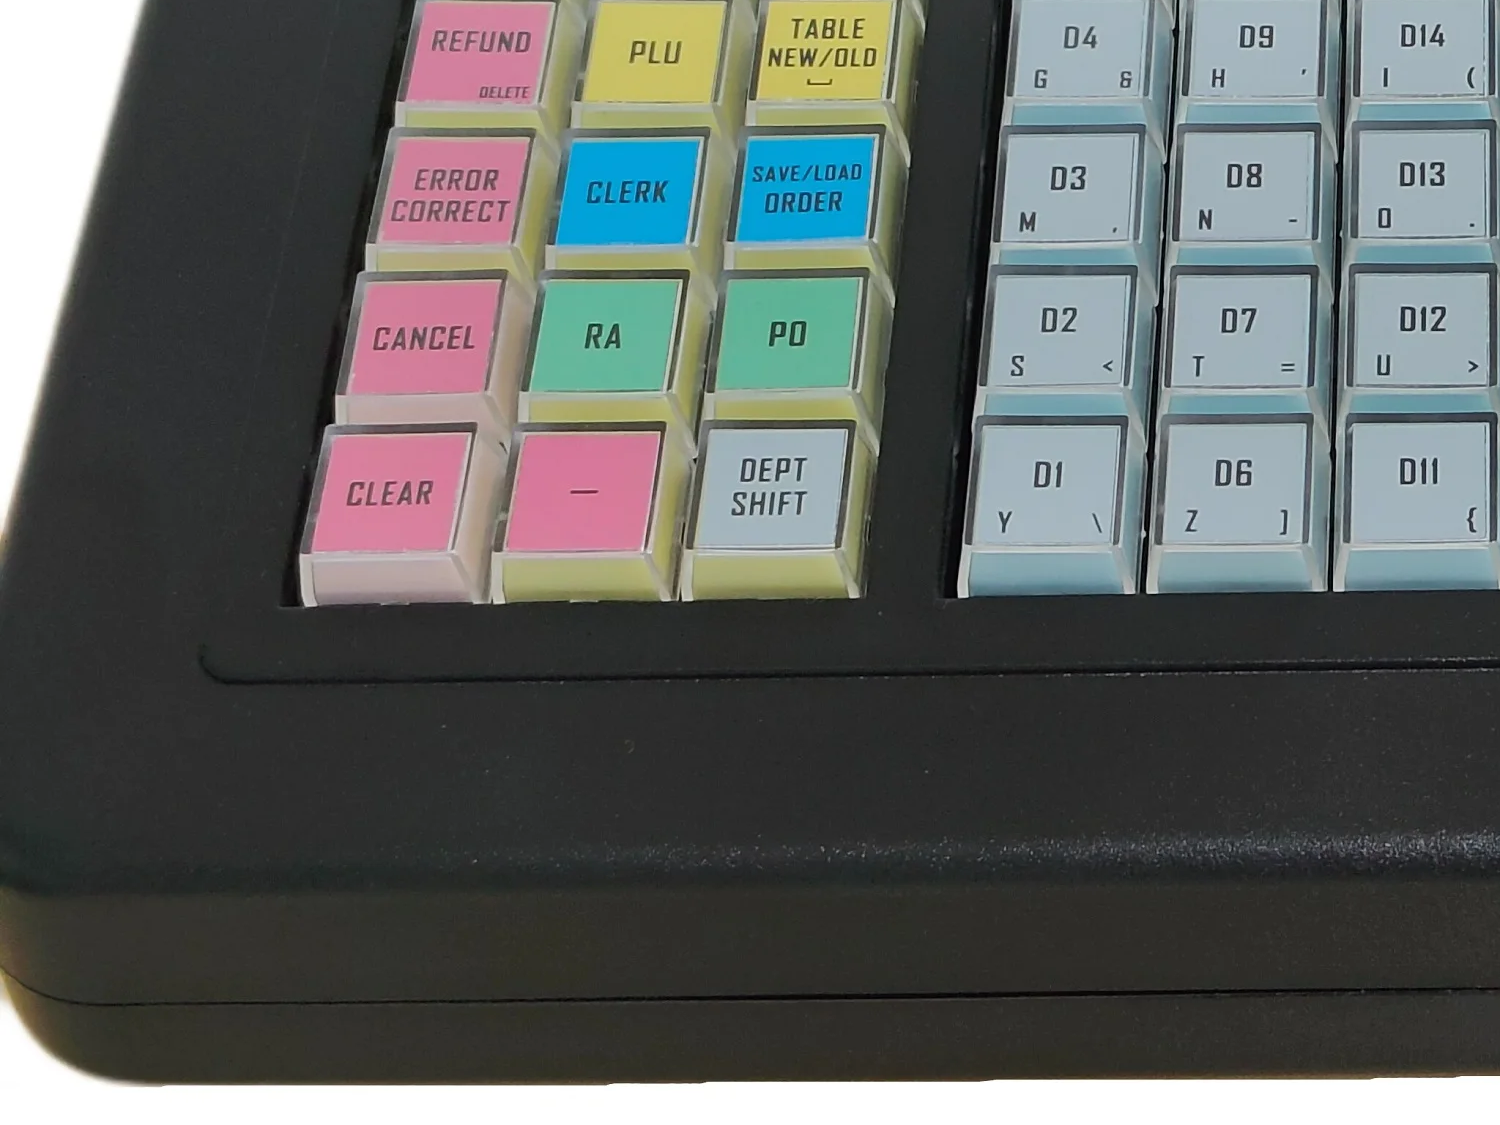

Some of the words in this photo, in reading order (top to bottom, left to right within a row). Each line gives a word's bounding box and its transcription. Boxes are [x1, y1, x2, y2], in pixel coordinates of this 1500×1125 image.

[792, 19, 865, 39] TABLE
[1064, 26, 1096, 48] D4
[1240, 26, 1273, 48] D9
[1401, 24, 1444, 47] D14
[432, 30, 531, 52] REFUND
[630, 41, 681, 63] PLU
[768, 48, 876, 67] NEW/OLD
[1035, 70, 1047, 88] G
[1212, 69, 1225, 87] H
[479, 87, 529, 98] DELETE
[415, 169, 499, 191] ERROR
[753, 164, 861, 182] SAVE/LOAD
[1051, 166, 1086, 190] D3
[1227, 164, 1262, 188] D8
[1400, 162, 1444, 186] D13
[587, 181, 668, 203] CLERK
[765, 192, 842, 213] ORDER
[391, 200, 510, 222] CORRECT
[1020, 212, 1036, 232] M
[1199, 209, 1212, 230] N
[1042, 308, 1077, 332] D2
[1222, 308, 1256, 333] D7
[1400, 307, 1446, 331] D12
[373, 326, 474, 350] CANCEL
[585, 324, 620, 349] RA
[1011, 356, 1024, 376] S
[1193, 356, 1204, 377] T
[1377, 355, 1390, 375] U
[741, 458, 807, 482] DEPT
[1034, 462, 1062, 487] D1
[1215, 460, 1252, 486] D6
[1400, 458, 1437, 484] D11
[347, 481, 433, 506] CLEAR
[732, 491, 807, 515] SHIFT
[999, 511, 1012, 533] Y
[1185, 510, 1198, 532] Z
